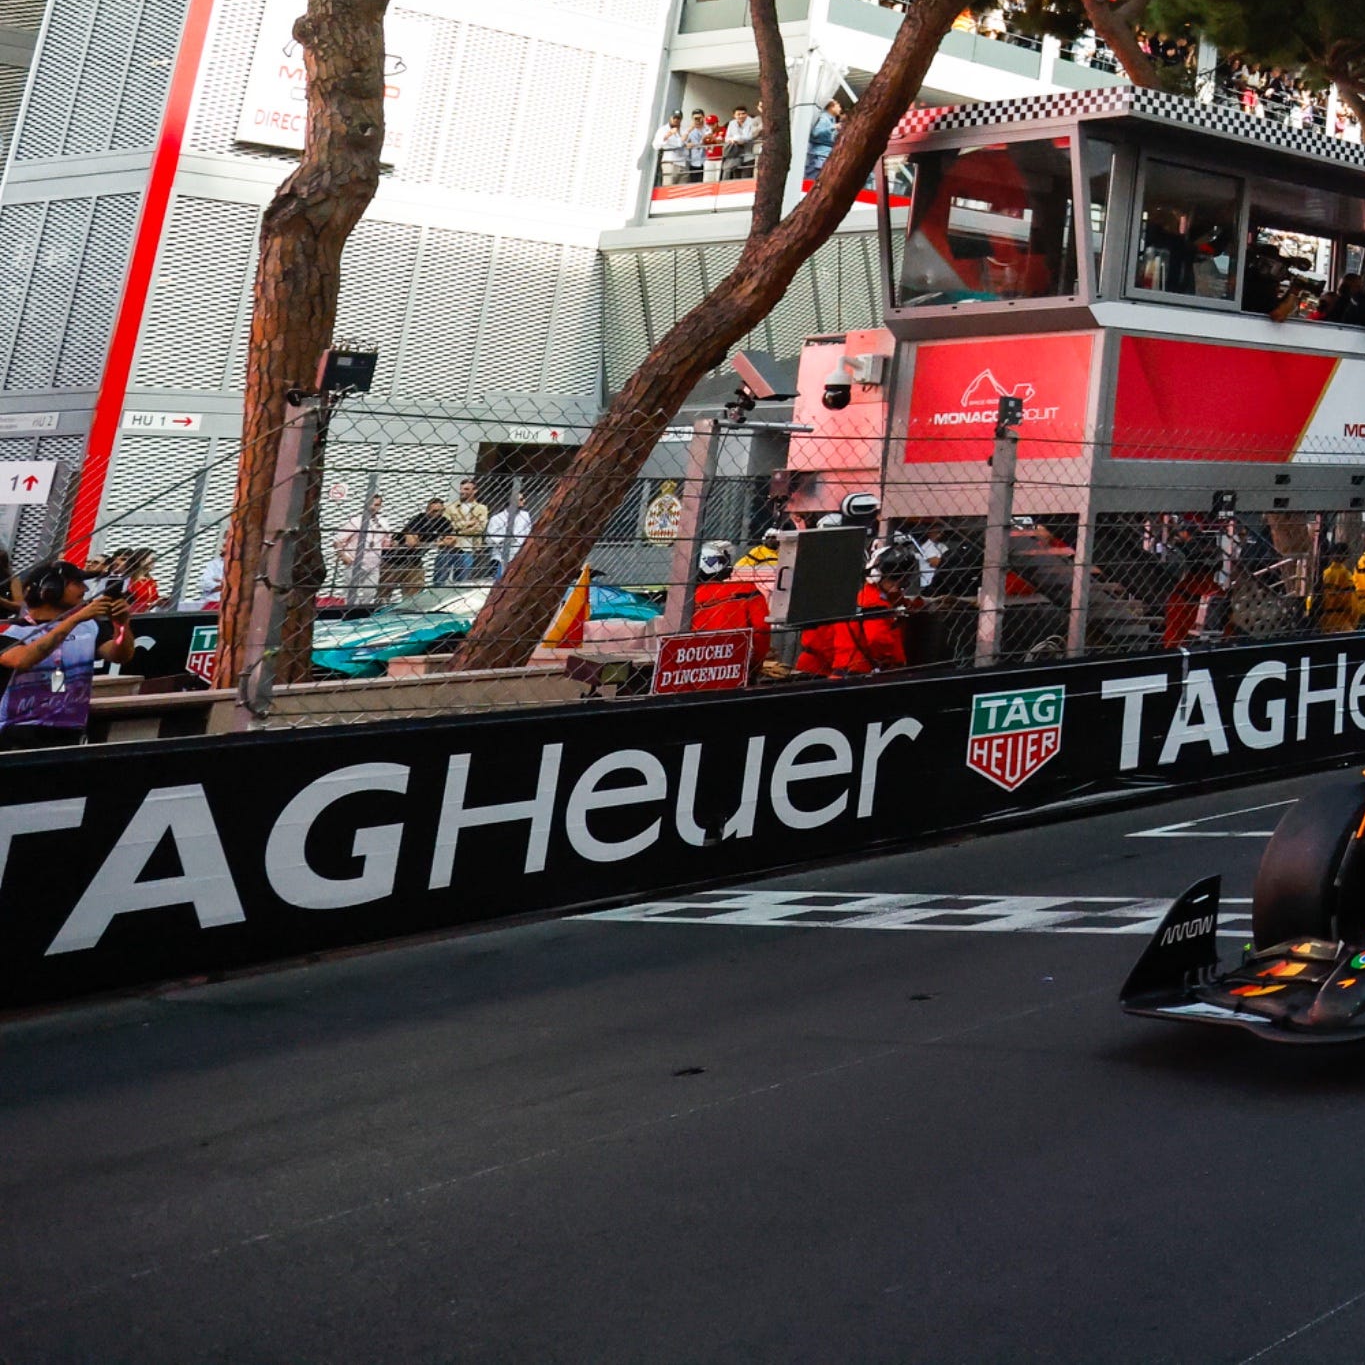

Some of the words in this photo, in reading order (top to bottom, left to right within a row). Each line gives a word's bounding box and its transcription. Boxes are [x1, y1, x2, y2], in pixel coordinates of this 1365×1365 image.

[132, 417, 153, 426] HU
[160, 416, 165, 426] 1
[675, 644, 734, 663] BOUCHE
[660, 664, 741, 687] D'INCENDIE
[981, 693, 1057, 730] TAG
[972, 731, 1056, 783] HEUER
